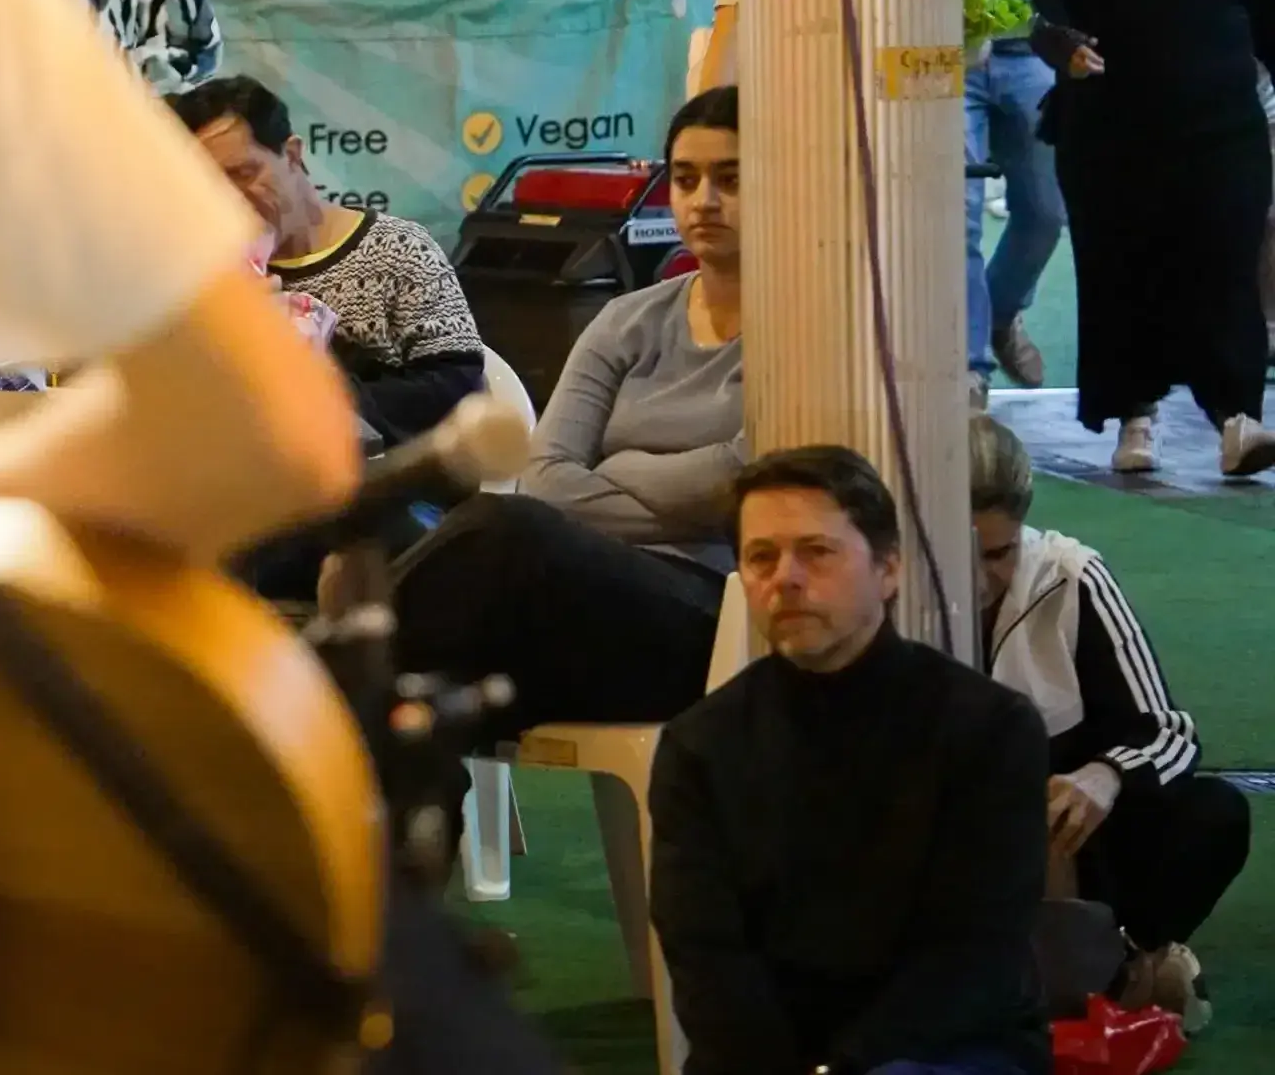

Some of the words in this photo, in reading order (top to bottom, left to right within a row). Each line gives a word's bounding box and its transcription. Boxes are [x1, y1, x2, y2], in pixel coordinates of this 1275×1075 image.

[309, 122, 388, 156] Free
[516, 112, 634, 150] Vegan
[314, 185, 389, 214] ree
[634, 227, 679, 239] HOND
